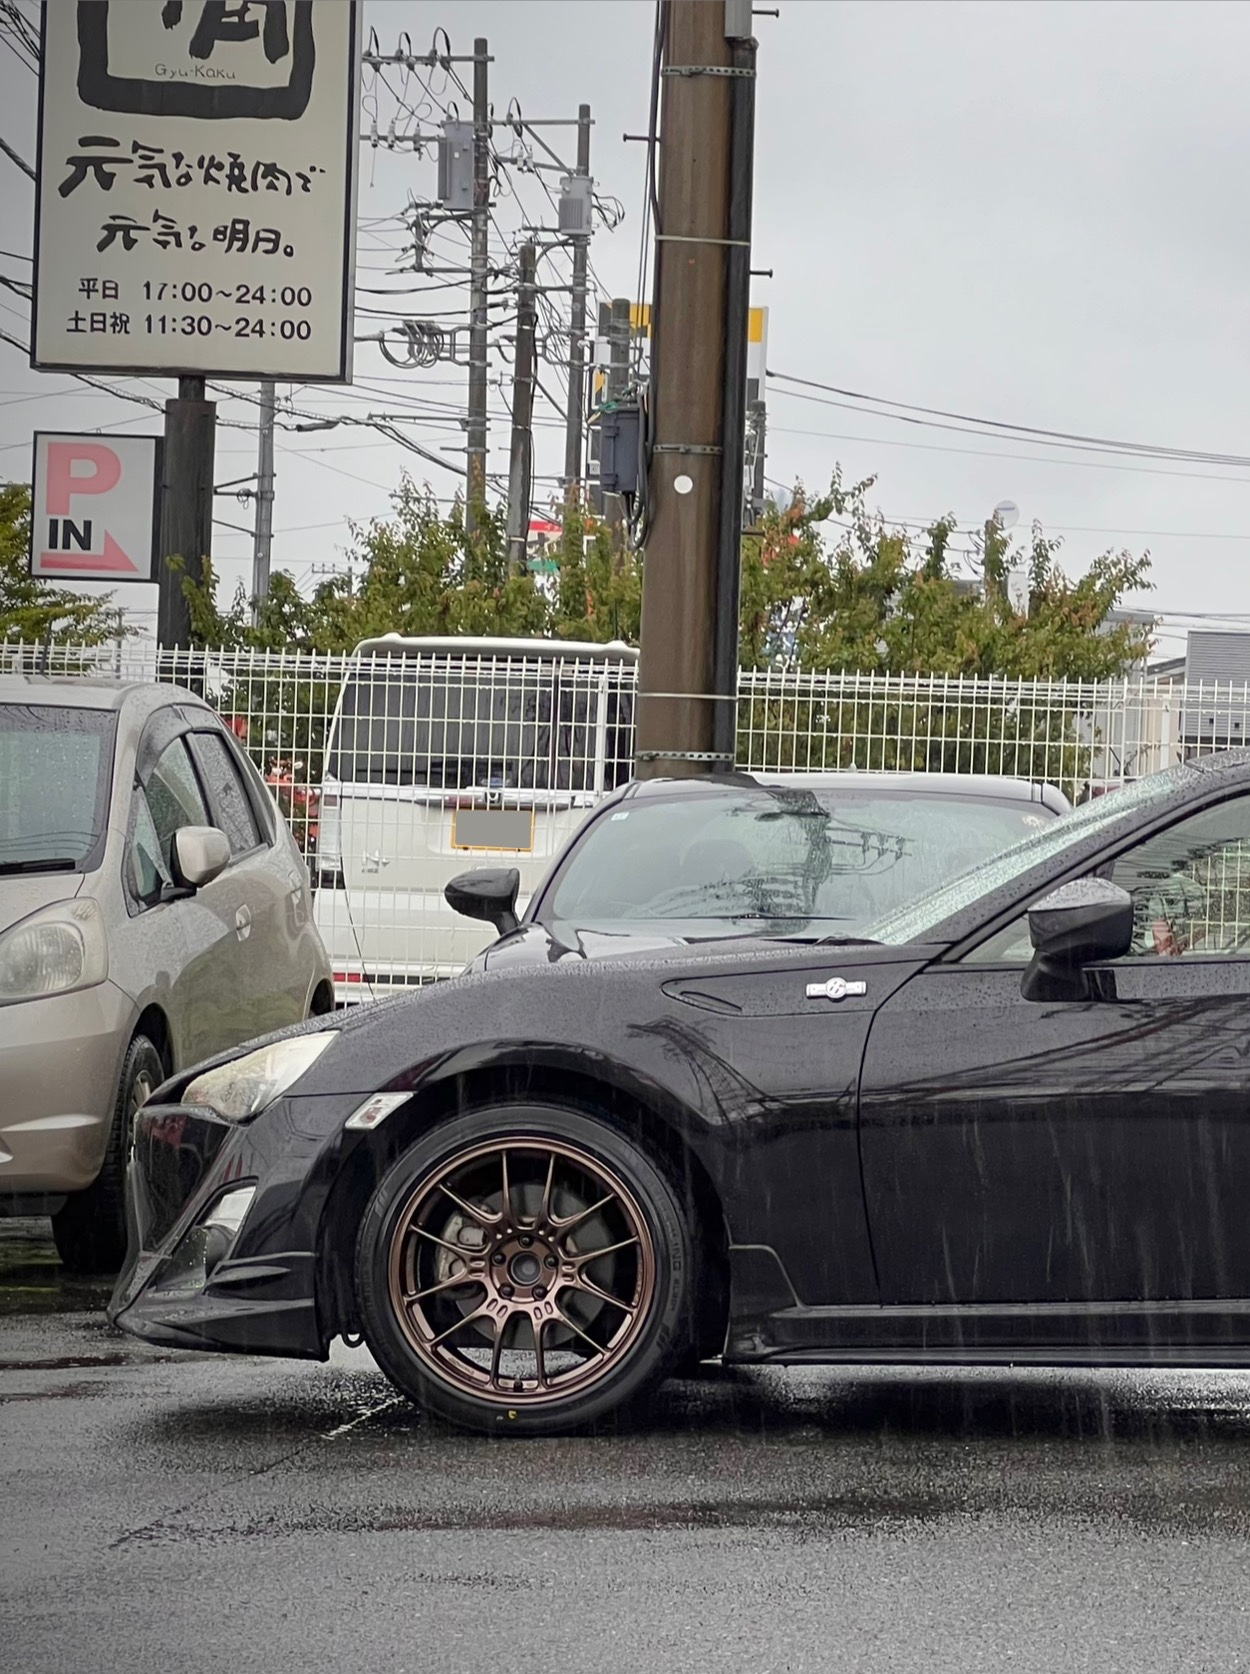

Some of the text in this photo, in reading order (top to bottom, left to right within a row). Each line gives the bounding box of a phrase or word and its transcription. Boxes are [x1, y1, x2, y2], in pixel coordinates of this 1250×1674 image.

[154, 63, 236, 80] Gyu-Kaku
[59, 135, 326, 198] 元気な焼肉で
[78, 277, 119, 300] 平日
[66, 310, 130, 335] 土日祝
[46, 442, 121, 516] P
[48, 518, 92, 551] IN
